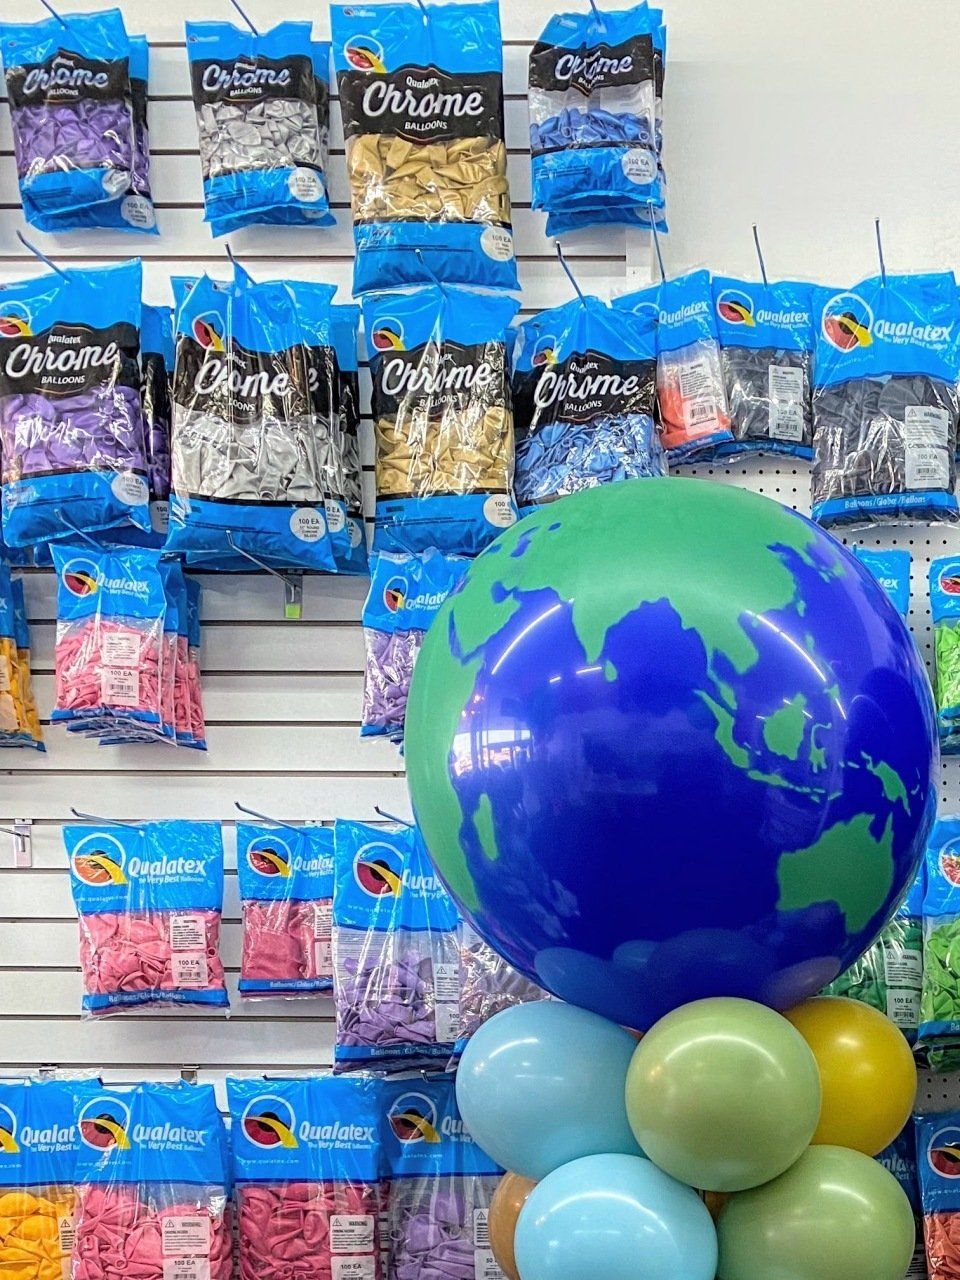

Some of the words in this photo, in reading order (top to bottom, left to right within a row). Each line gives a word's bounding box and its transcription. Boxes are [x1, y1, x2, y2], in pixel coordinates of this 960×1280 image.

[23, 66, 109, 95] Chrome
[202, 63, 292, 92] Chrome
[362, 81, 485, 118] Chrome
[404, 120, 448, 131] BALLOONS
[659, 301, 709, 326] Qualatex
[756, 308, 809, 325] Qualatex
[874, 319, 951, 343] Qualatex
[5, 341, 117, 378] Chrome
[41, 375, 85, 384] BALLOONS
[382, 358, 494, 397] Chrome
[534, 370, 640, 408] Chrome
[564, 400, 602, 412] BALLOONS
[298, 518, 310, 526] 100
[311, 519, 320, 527] EA
[97, 572, 150, 593] Qualatex
[128, 856, 206, 878] Qualatex
[294, 856, 333, 873] Quala
[147, 876, 163, 886] Very
[164, 875, 180, 883] Best
[20, 1126, 75, 1146] Qualat
[133, 1122, 207, 1146] Qualatex
[299, 1121, 374, 1143] Qualatex
[37, 1144, 55, 1153] Very
[56, 1143, 72, 1151] Best
[148, 1142, 165, 1150] Very
[166, 1142, 182, 1150] Best
[318, 1141, 333, 1150] Very
